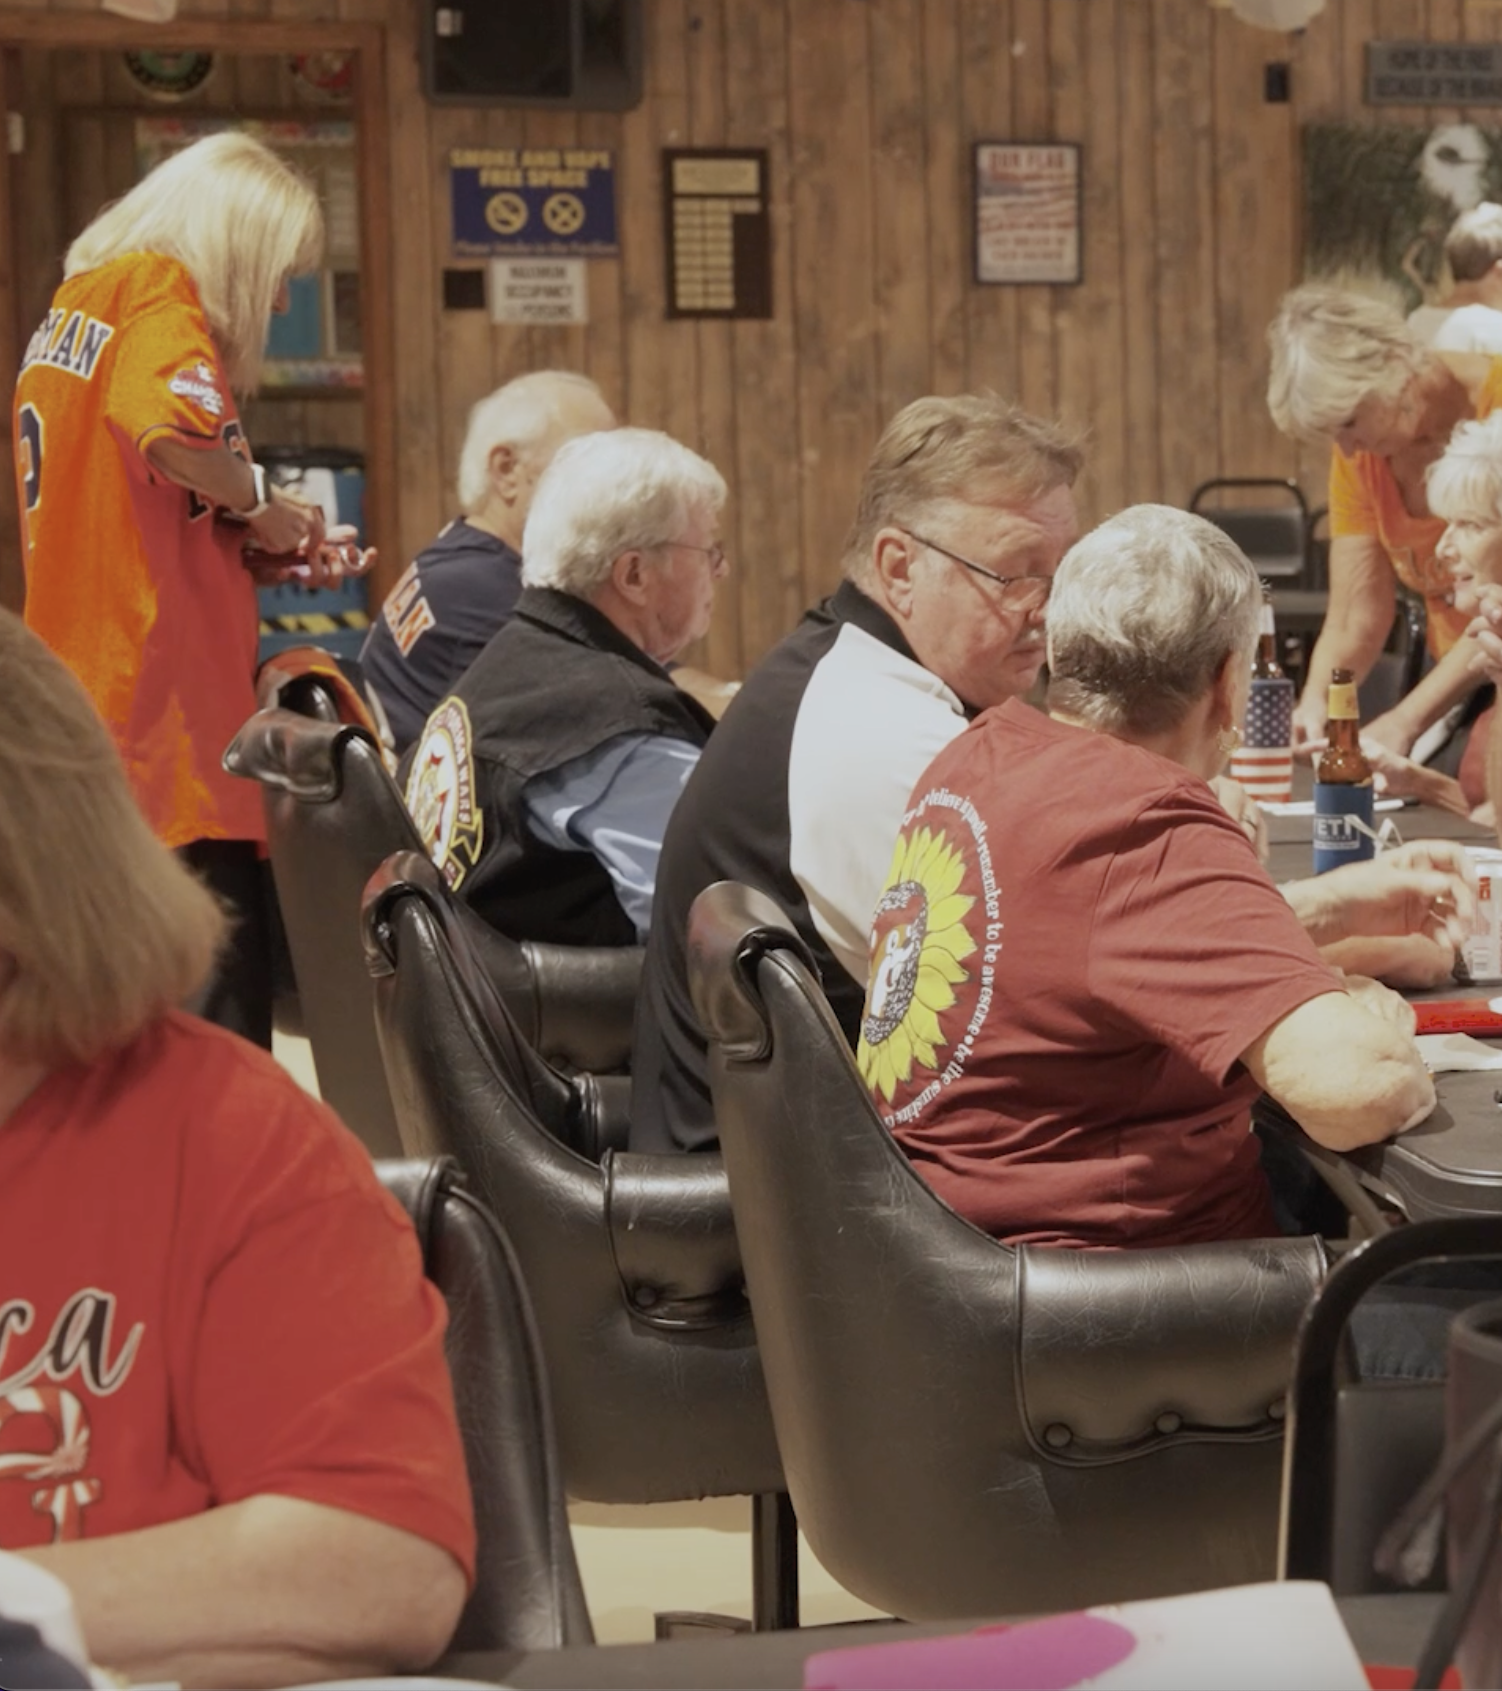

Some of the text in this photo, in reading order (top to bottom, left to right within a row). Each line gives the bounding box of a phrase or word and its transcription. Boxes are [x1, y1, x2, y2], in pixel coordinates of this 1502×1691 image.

[450, 151, 610, 169] SMOKE AND VAPE
[479, 169, 588, 188] FREE SPACE
[457, 769, 473, 824] WARS
[1314, 817, 1352, 836] ETI
[976, 842, 1001, 920] remember
[986, 922, 1004, 940] to
[983, 943, 1003, 963] be
[967, 967, 996, 1036] awesome
[953, 1042, 975, 1063] be
[940, 1059, 964, 1086] the
